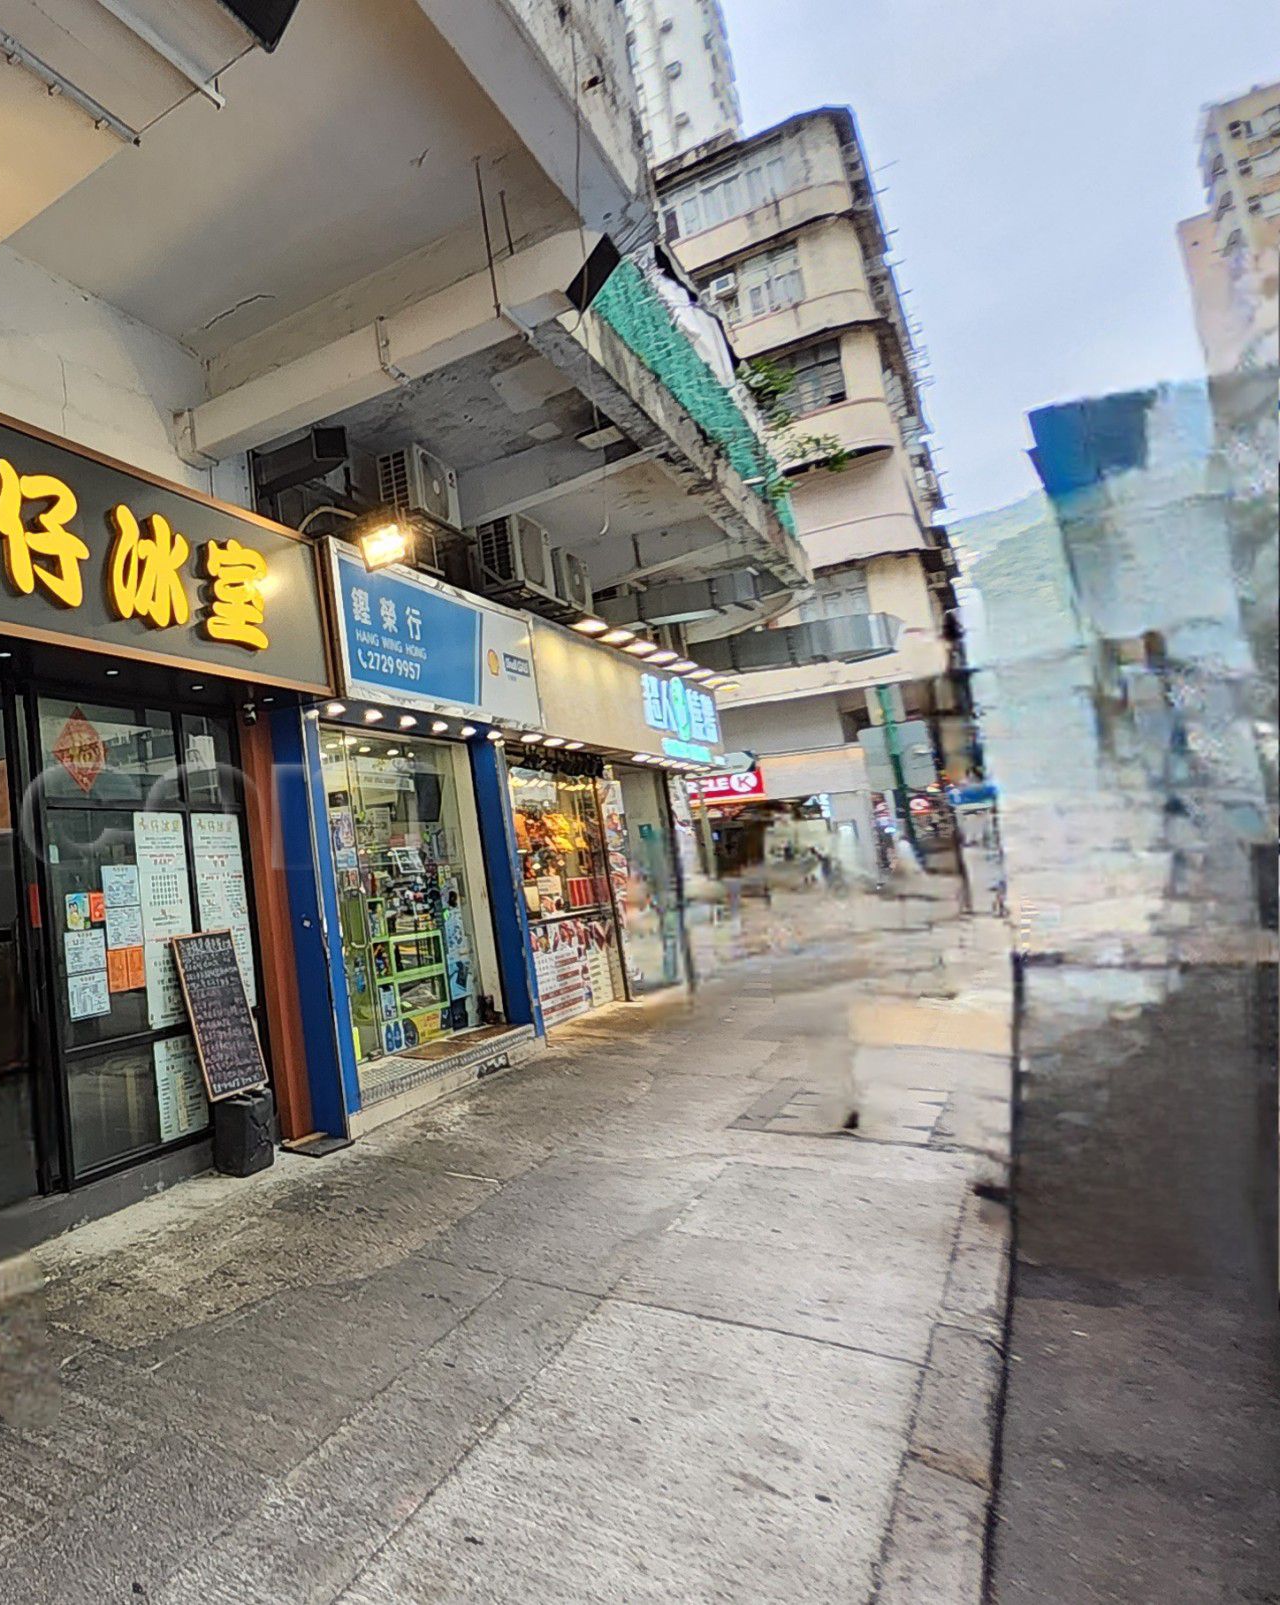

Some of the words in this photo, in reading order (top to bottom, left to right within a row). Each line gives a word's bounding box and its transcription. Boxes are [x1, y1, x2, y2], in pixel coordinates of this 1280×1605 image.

[356, 629, 380, 648] HANG
[367, 651, 394, 674] 2729
[396, 658, 421, 681] 9957
